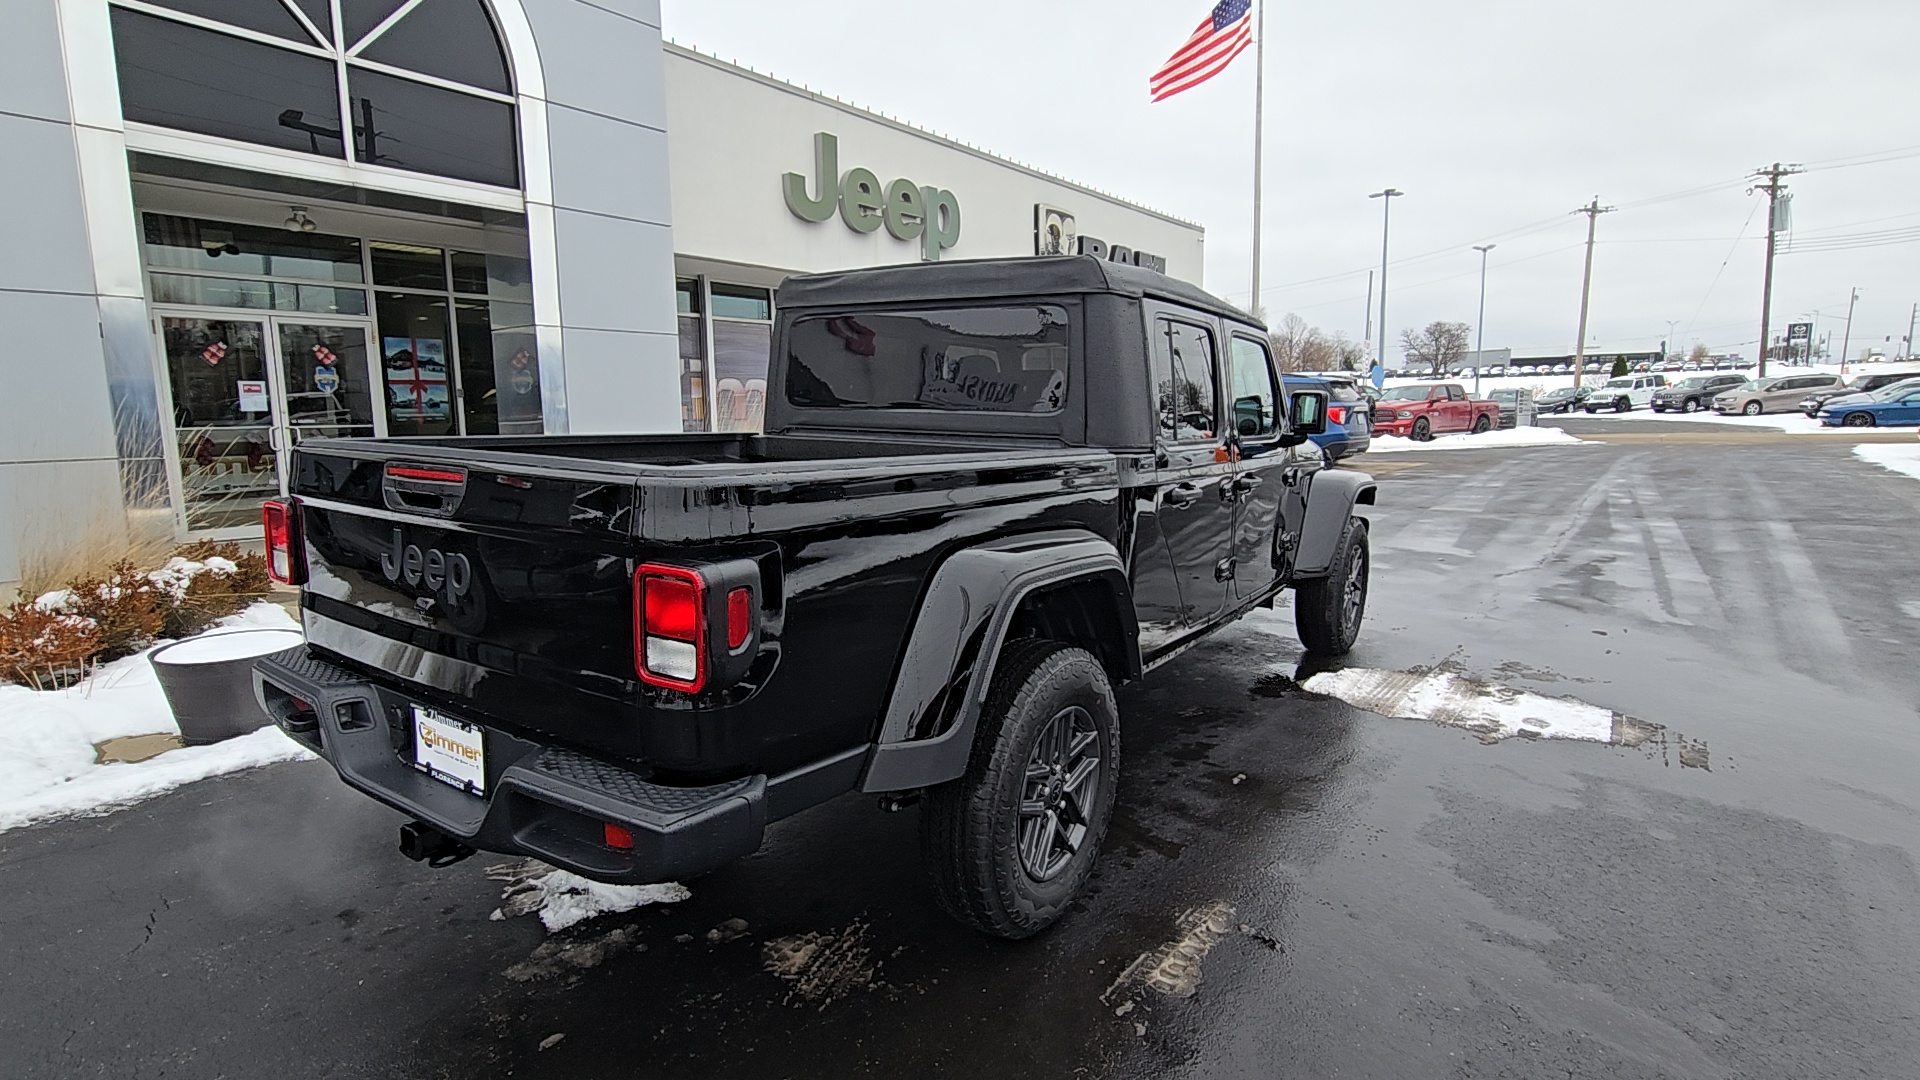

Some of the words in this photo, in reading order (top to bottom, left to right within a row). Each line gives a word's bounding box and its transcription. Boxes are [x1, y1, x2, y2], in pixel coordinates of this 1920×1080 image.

[782, 132, 961, 261] Jeep
[381, 527, 471, 607] Jeep
[422, 724, 482, 761] Zimmer
